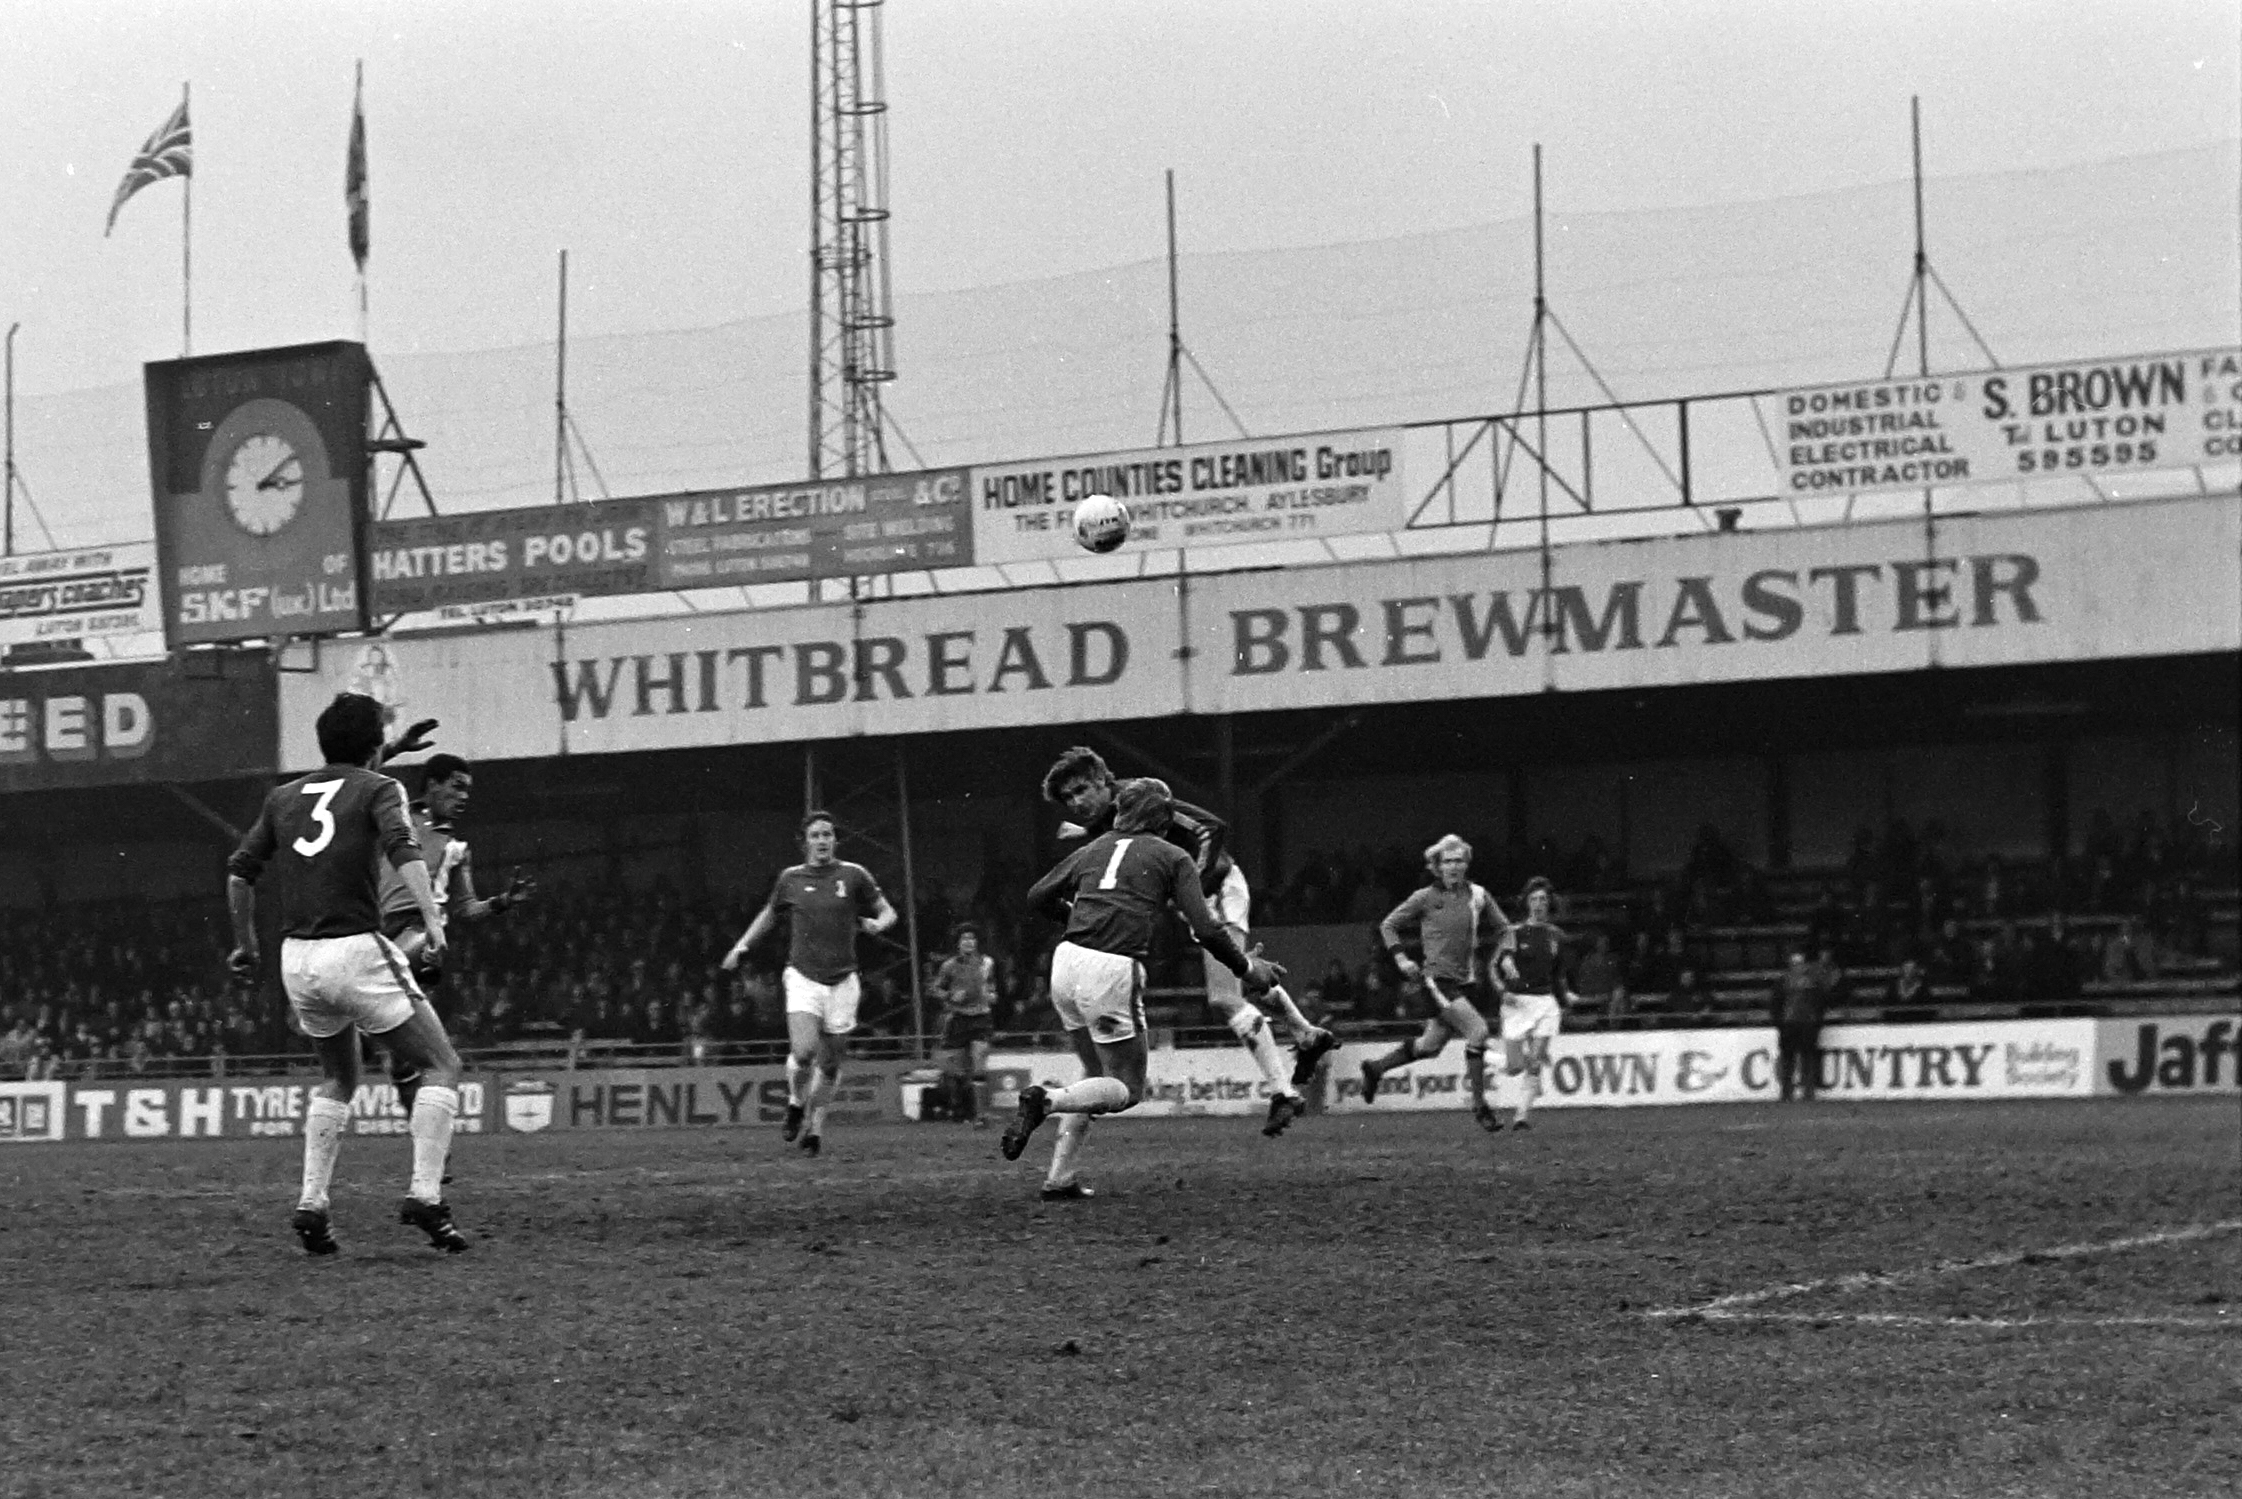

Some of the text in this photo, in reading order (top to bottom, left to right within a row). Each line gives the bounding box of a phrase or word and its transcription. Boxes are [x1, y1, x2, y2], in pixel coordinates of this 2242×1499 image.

[1787, 383, 1941, 415] DOMESTIC
[2030, 361, 2185, 415] BROWN
[1788, 412, 1940, 441] INDUSTRIAL
[2045, 412, 2165, 443] LUTON
[1790, 435, 1953, 466] ELECTRICAL
[983, 446, 1392, 509] HOME COUNTIES CLEANING Group
[1792, 458, 1969, 490] CONTRACTOR
[735, 484, 866, 522] ERECTION
[1014, 511, 1048, 531] THE
[372, 528, 647, 579] HATTERS POOLS
[180, 586, 269, 625] SKF
[551, 553, 2045, 721] WHITBREAD BREWMASTER
[292, 778, 346, 858] 3
[1098, 838, 1134, 890] 1
[1553, 1044, 1996, 1095] OWN & CUNTRY
[570, 1080, 789, 1127] HENLYS
[1190, 1077, 1253, 1101] better
[354, 1117, 482, 1135] DISCTS
